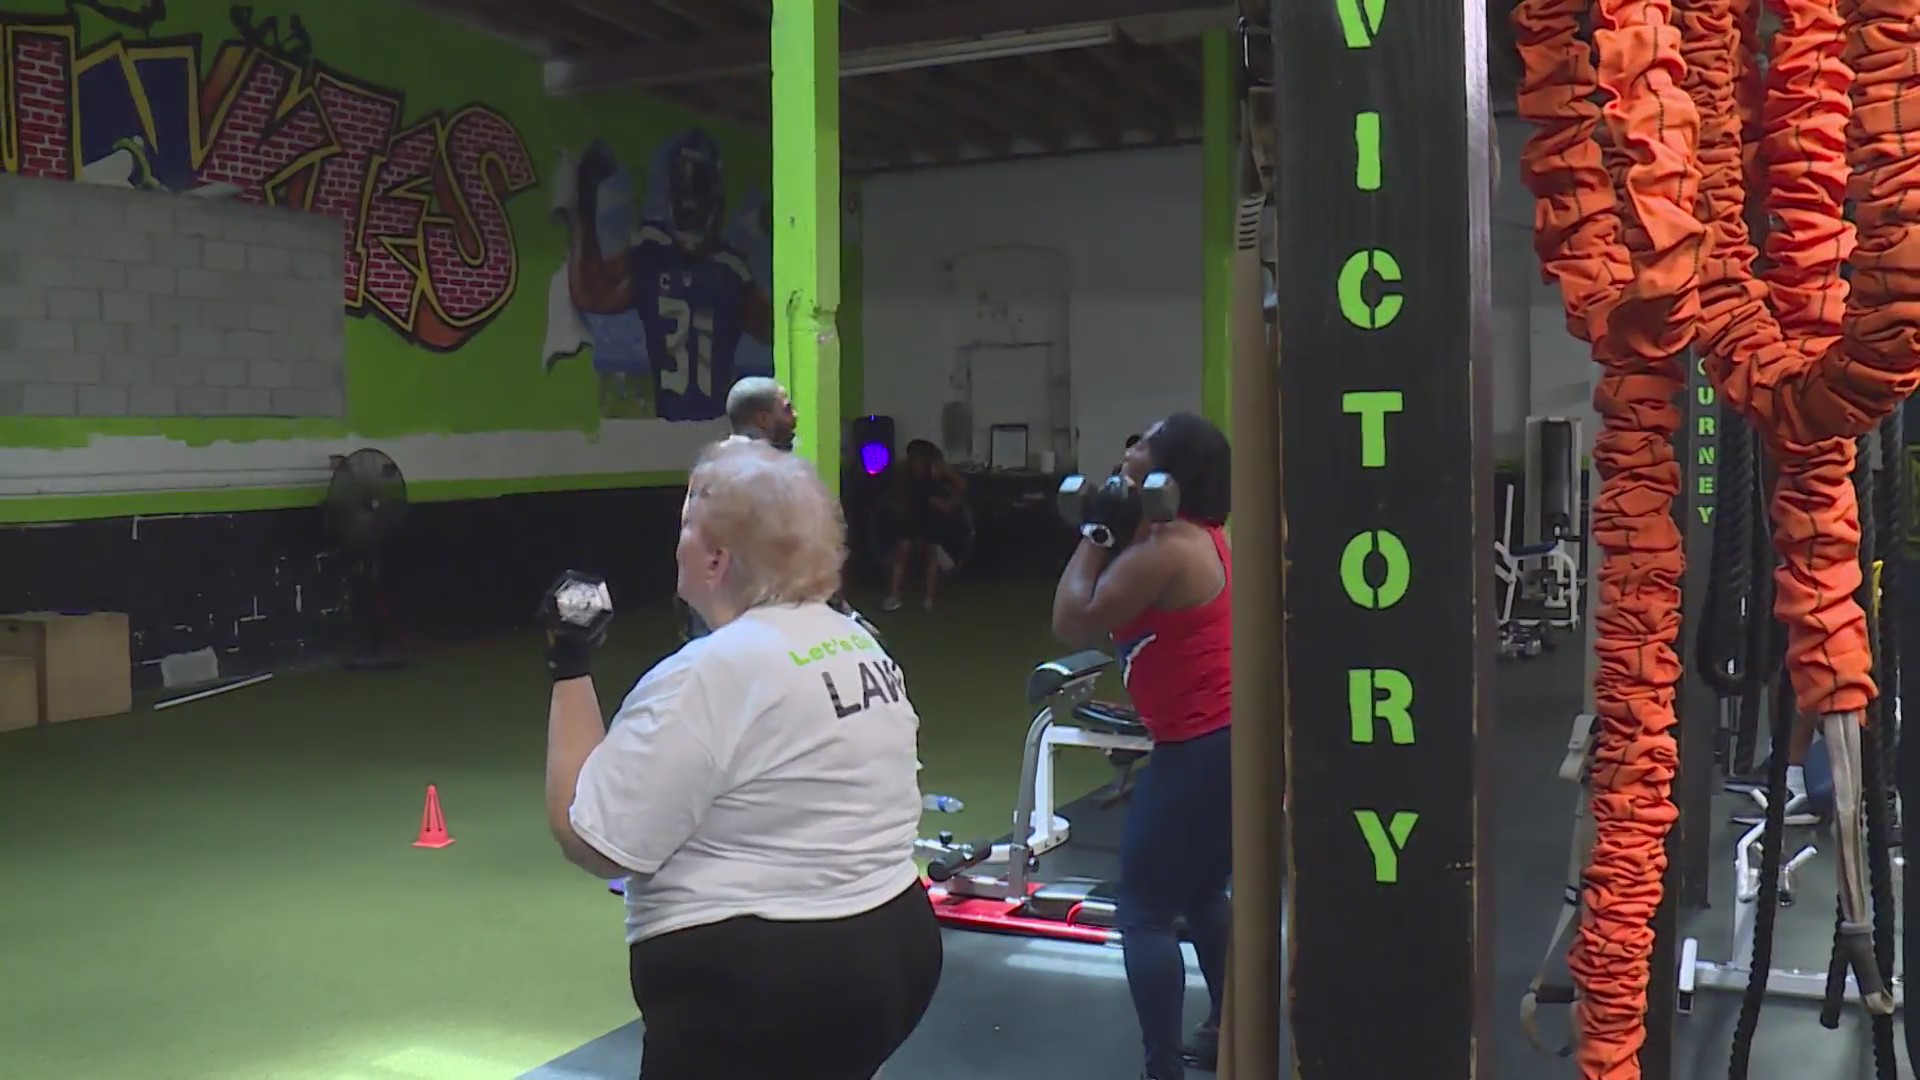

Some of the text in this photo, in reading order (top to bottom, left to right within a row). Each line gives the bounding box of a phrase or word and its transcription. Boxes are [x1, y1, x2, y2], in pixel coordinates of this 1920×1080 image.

[658, 296, 714, 397] 31
[1336, 0, 1420, 884] VICTORY
[788, 638, 853, 666] Let's
